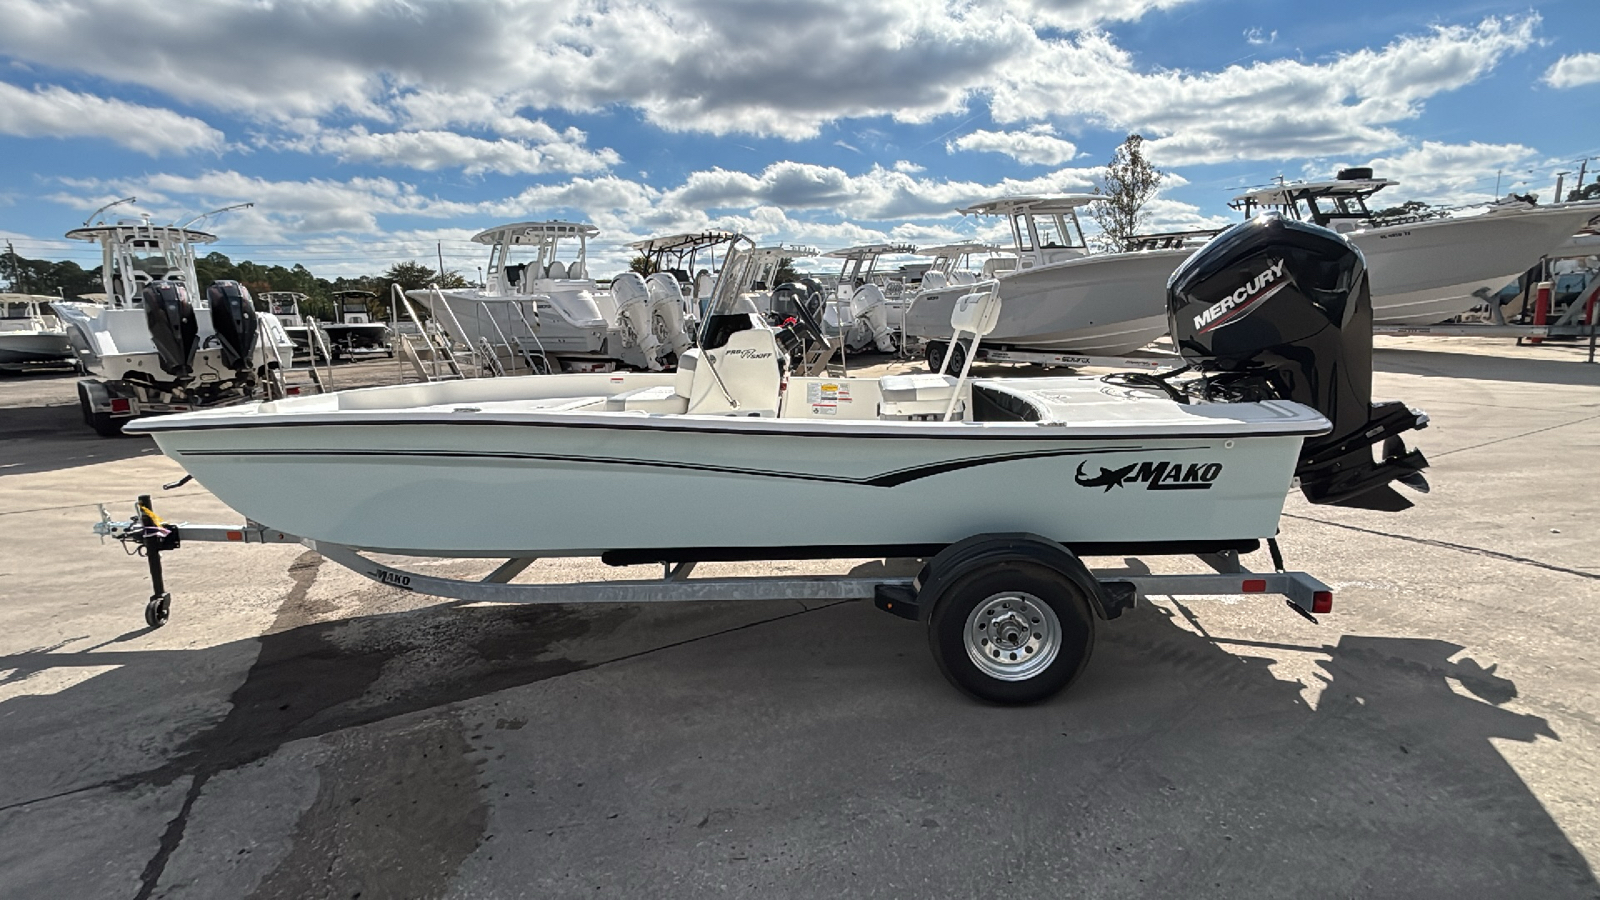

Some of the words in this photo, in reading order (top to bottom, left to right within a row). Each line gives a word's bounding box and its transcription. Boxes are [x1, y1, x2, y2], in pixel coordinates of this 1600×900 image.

[1193, 258, 1284, 330] MERCURY
[1123, 461, 1223, 490] MAKO
[368, 569, 413, 590] MAKO
